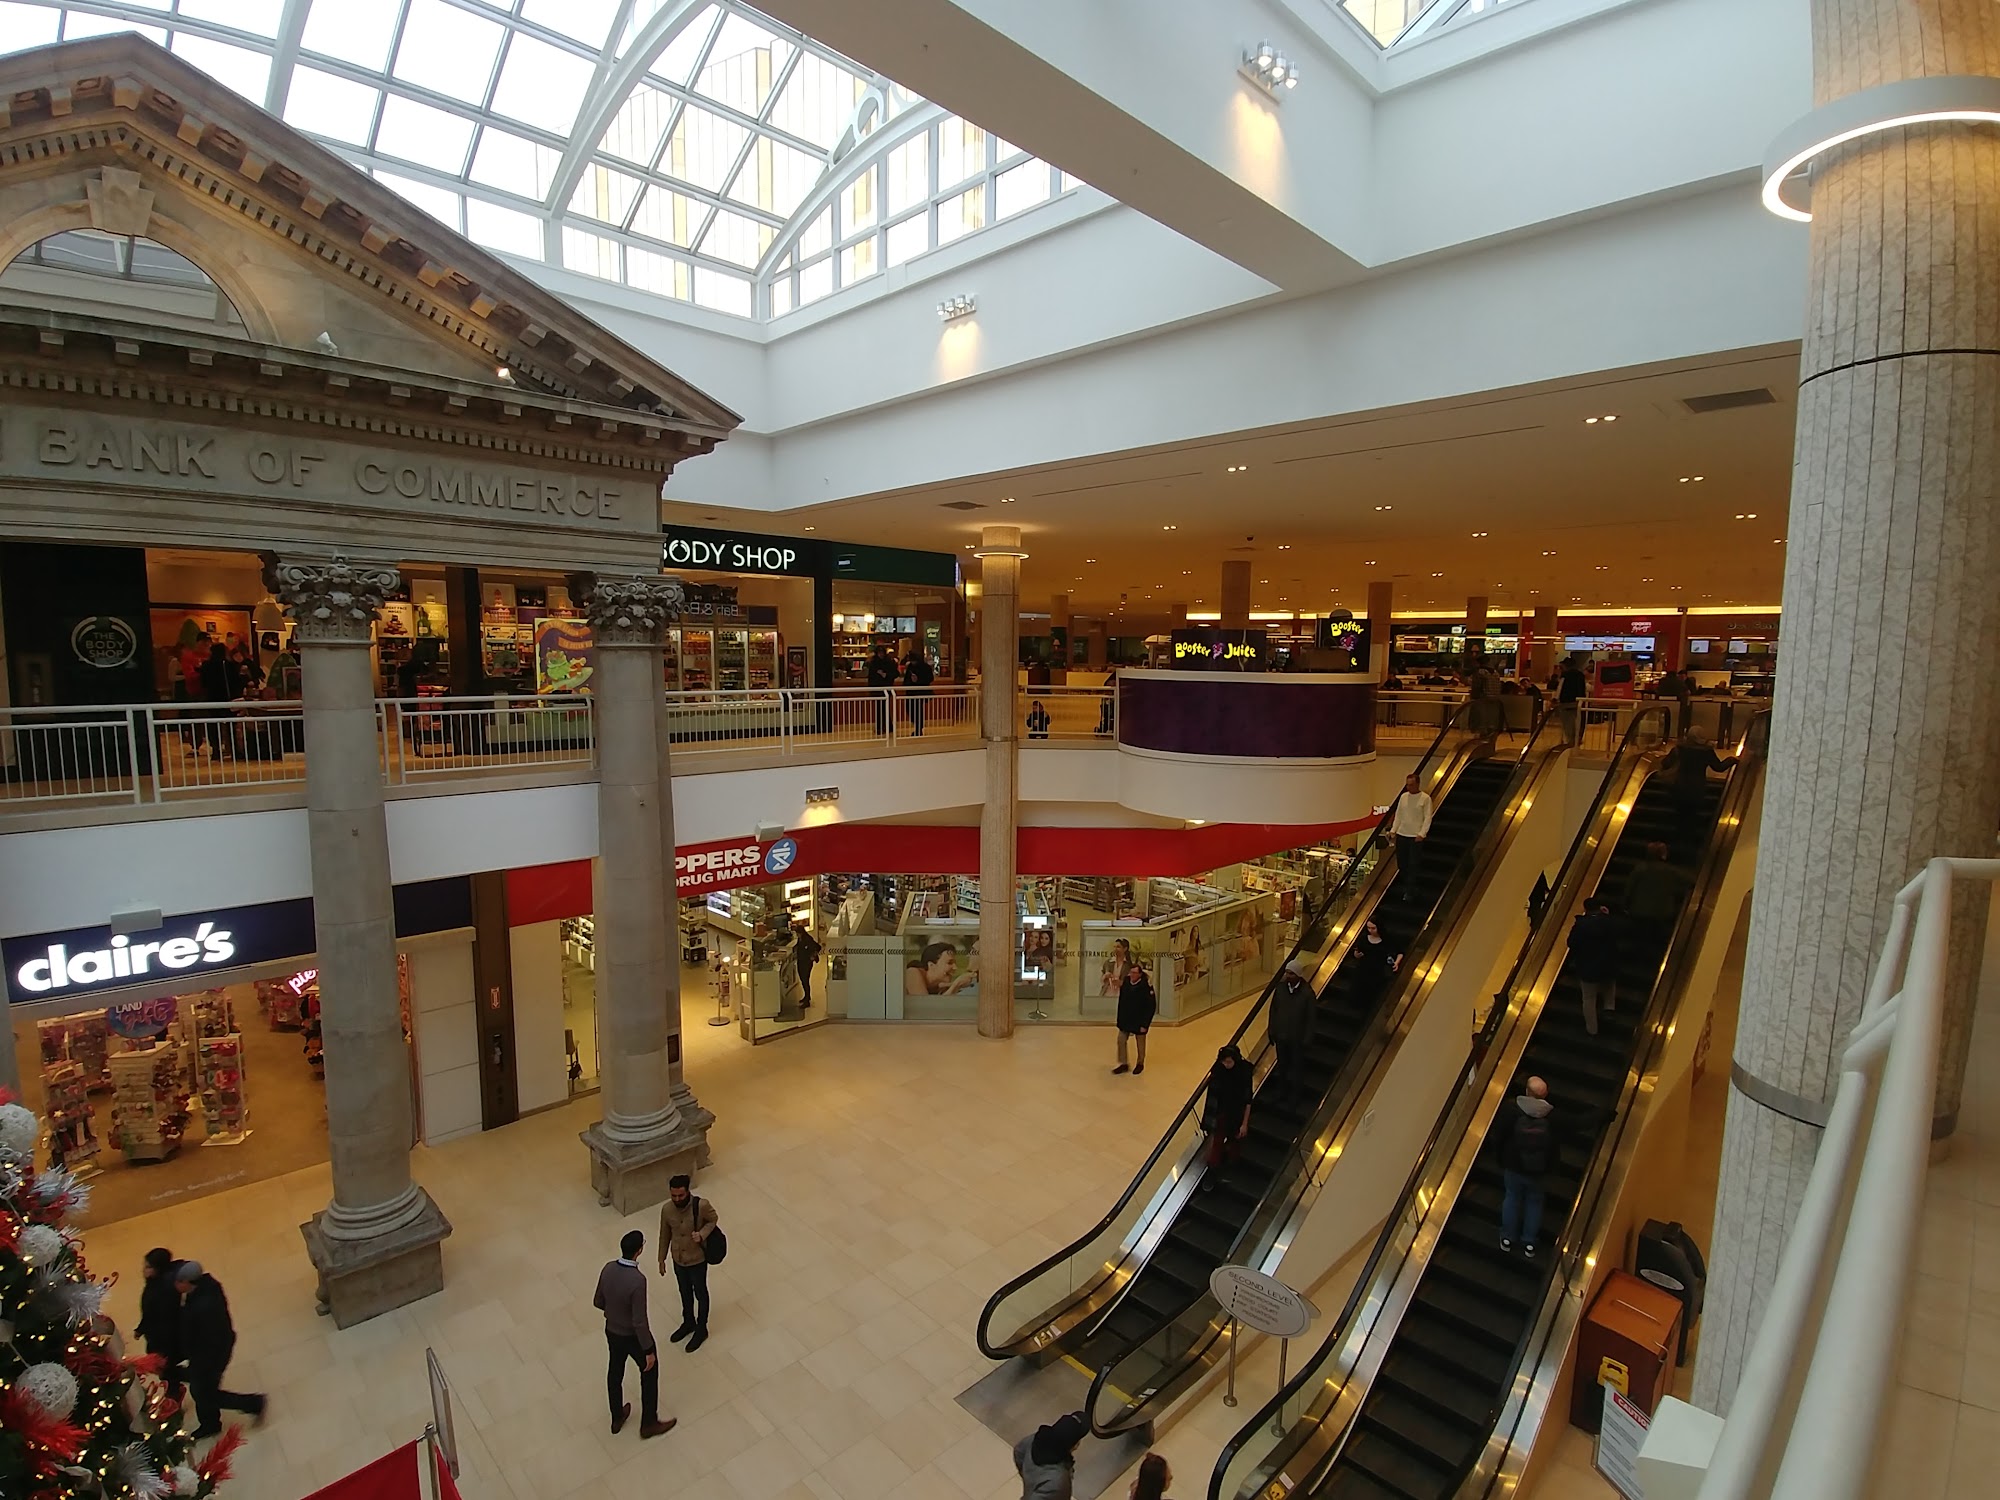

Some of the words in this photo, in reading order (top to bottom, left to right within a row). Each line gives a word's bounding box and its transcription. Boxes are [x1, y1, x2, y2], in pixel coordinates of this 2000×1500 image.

[39, 426, 216, 478] BANK
[249, 447, 325, 487] OF
[355, 456, 622, 521] COMMERCE
[732, 544, 796, 571] SHOP
[93, 632, 115, 640] THE
[1331, 621, 1364, 637] Booster
[85, 640, 125, 649] BODY
[89, 649, 124, 658] SHOP
[1175, 642, 1211, 658] Booster
[1224, 642, 1256, 659] Juice
[676, 872, 714, 887] RUG
[716, 865, 761, 881] MART
[17, 921, 235, 992] claire's
[1077, 950, 1109, 958] ENTRANCE
[288, 968, 319, 995] pie
[115, 1001, 143, 1014] LAND
[1228, 1271, 1265, 1291] SECOND
[1267, 1289, 1294, 1306] LEVEL
[1618, 1398, 1649, 1428] CAUTIO
